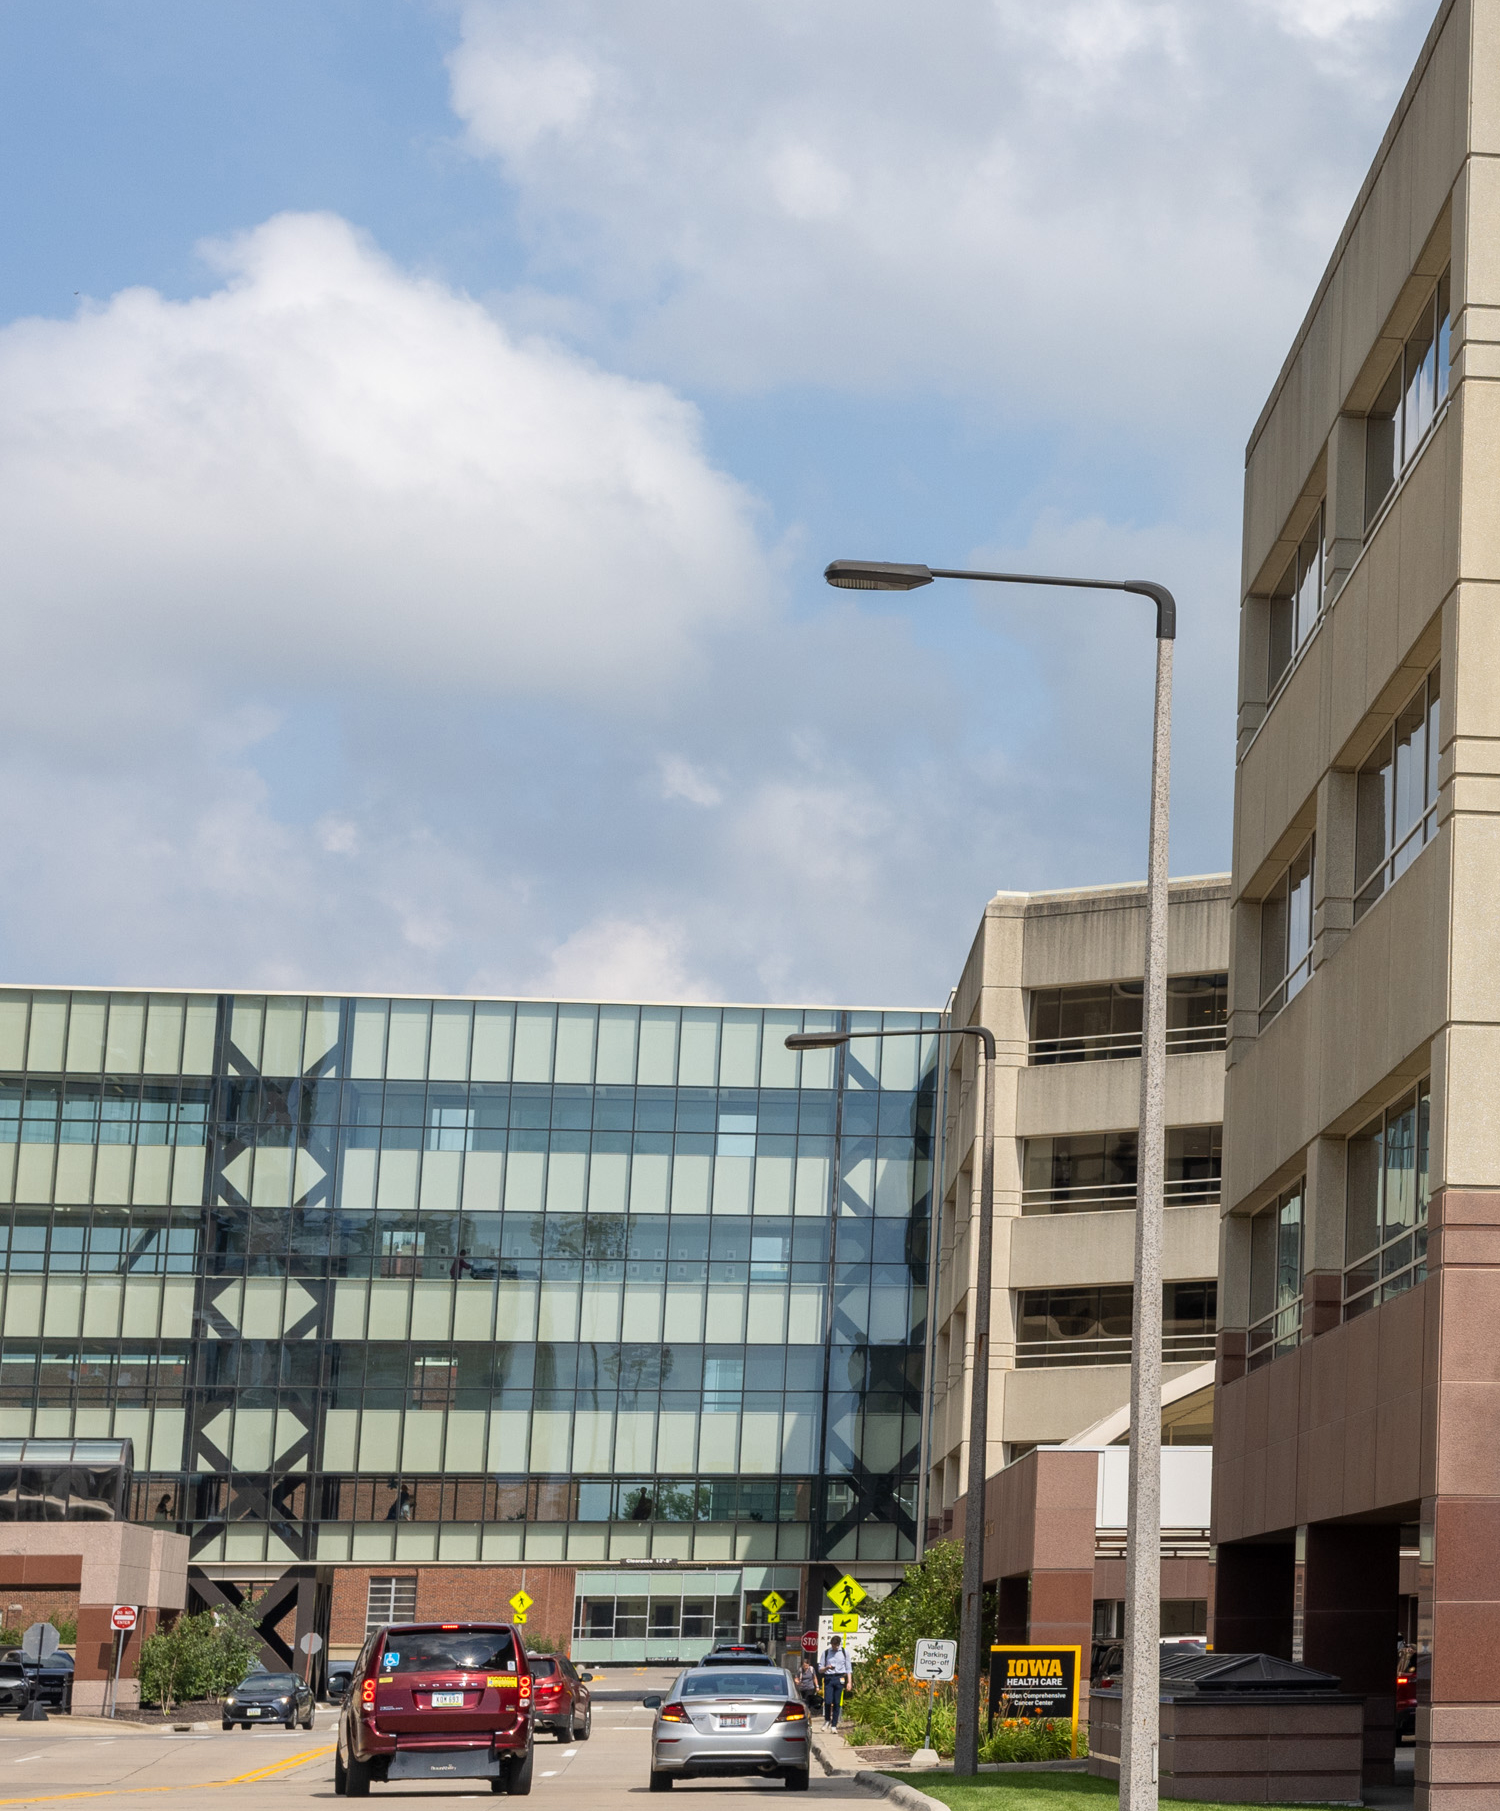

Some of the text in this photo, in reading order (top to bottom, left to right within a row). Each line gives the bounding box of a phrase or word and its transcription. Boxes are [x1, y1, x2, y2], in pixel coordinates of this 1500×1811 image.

[923, 1651, 948, 1659] Parking
[1007, 1659, 1063, 1677] IOWA
[1006, 1678, 1063, 1686] HEALTH CARE
[1023, 1692, 1066, 1700] Comprehensive
